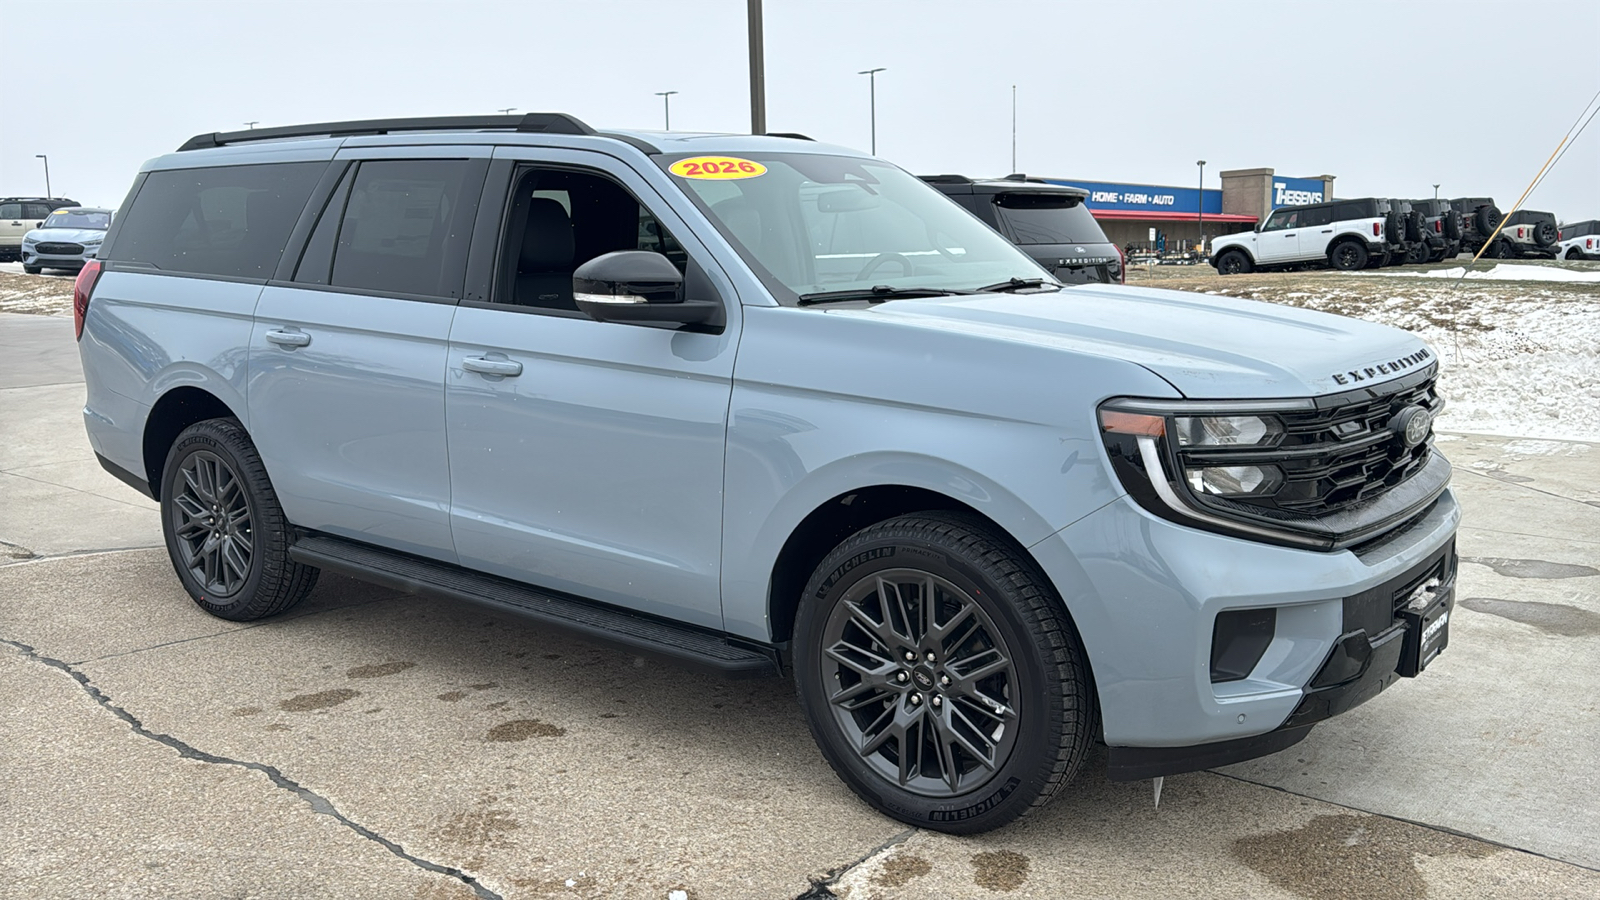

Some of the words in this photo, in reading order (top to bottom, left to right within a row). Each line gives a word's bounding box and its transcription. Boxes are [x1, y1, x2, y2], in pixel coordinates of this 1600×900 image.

[683, 161, 756, 175] 2026
[1091, 191, 1118, 203] HOME
[1124, 193, 1147, 204] FARM
[1152, 195, 1174, 205] AUTO
[1059, 257, 1107, 265] EXPEDITION
[1332, 348, 1430, 385] EXPEDITION
[829, 547, 892, 583] MICHELIN
[901, 547, 931, 557] PRIMACY
[933, 793, 1004, 820] MICHELIN
